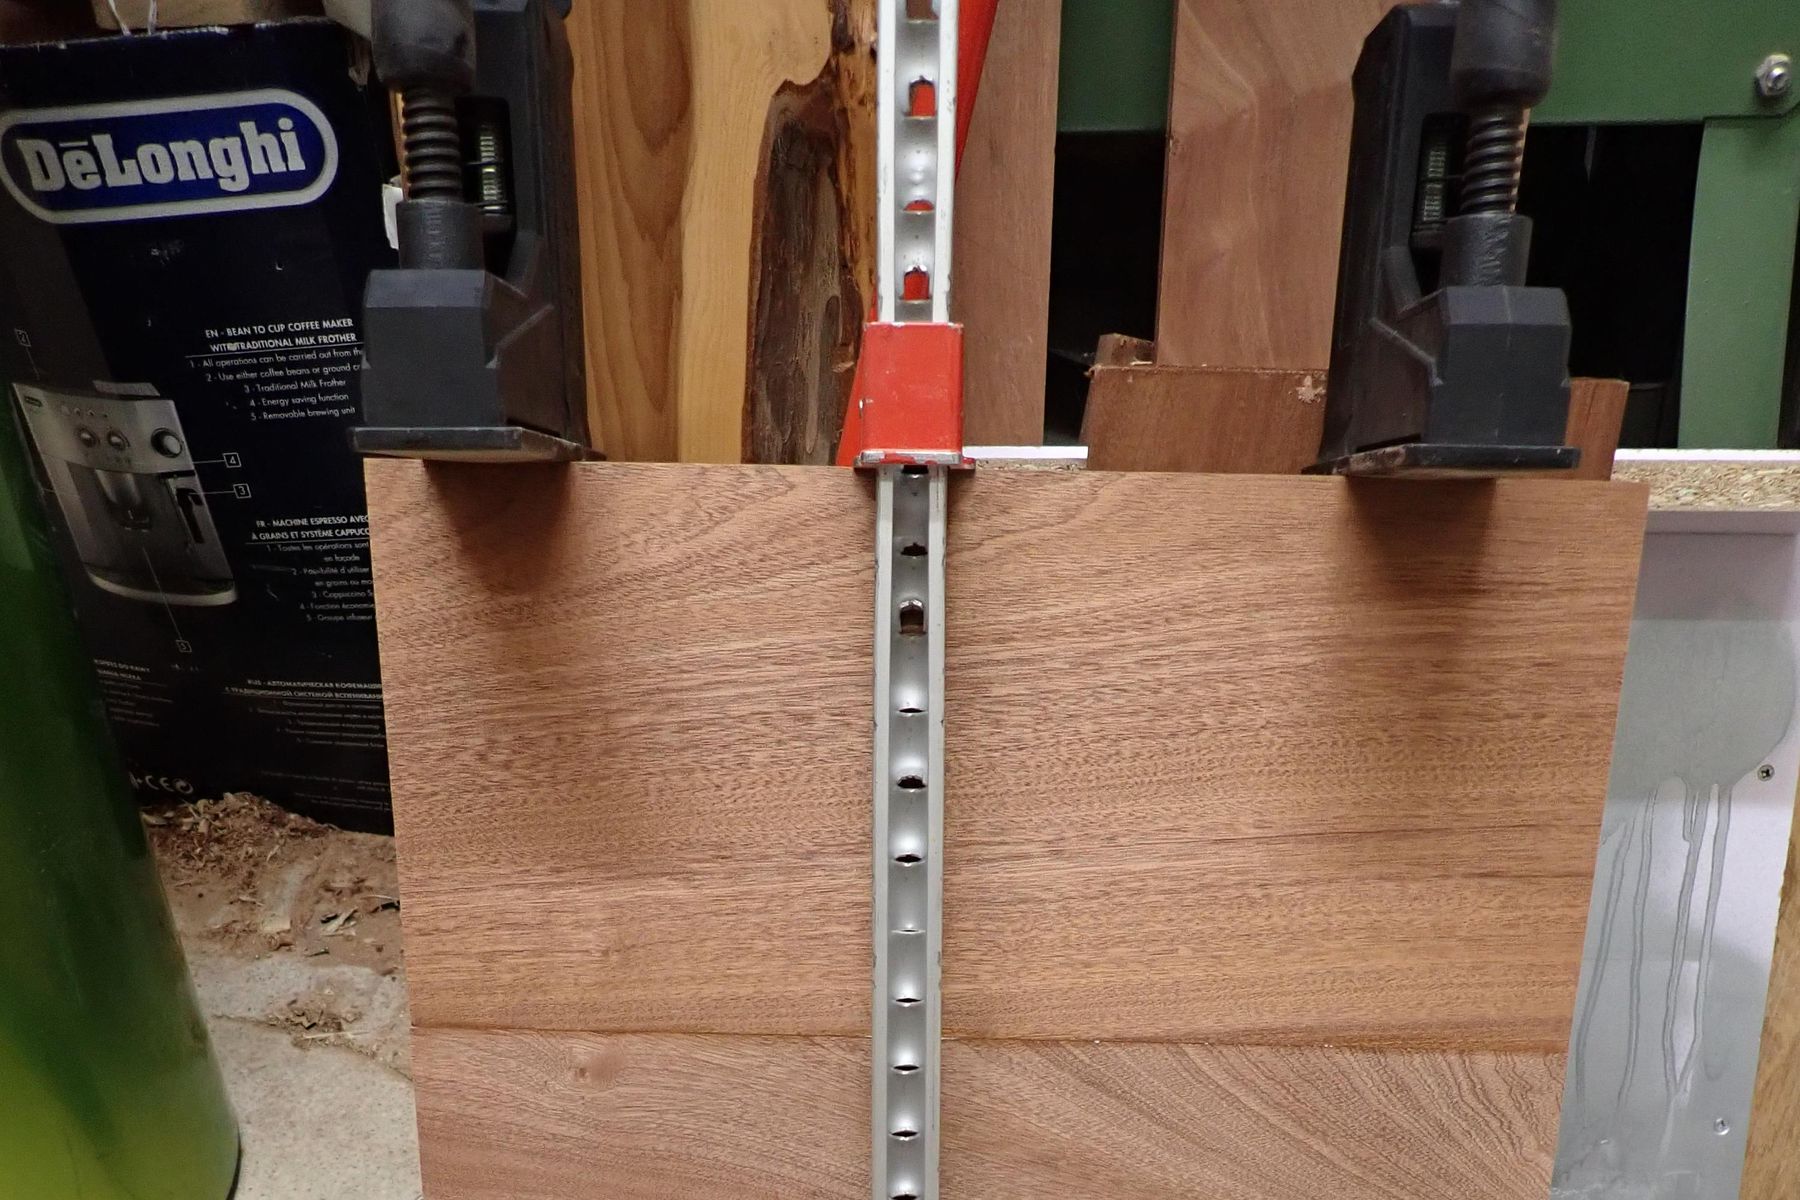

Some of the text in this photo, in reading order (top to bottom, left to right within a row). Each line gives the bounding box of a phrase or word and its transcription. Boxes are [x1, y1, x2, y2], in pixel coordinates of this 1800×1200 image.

[205, 329, 219, 339] EN
[227, 326, 251, 337] BEAN
[253, 324, 266, 334] TO
[268, 323, 286, 333] CUP
[288, 321, 320, 331] COFFEE
[322, 318, 354, 329] MAKER
[235, 338, 293, 351] TRADITIONAL
[295, 336, 316, 346] MILK
[317, 333, 357, 344] FROTHER
[202, 358, 214, 368] All
[215, 354, 258, 369] operations
[259, 355, 275, 364] can
[276, 353, 287, 363] be
[288, 349, 317, 361] carried
[318, 349, 332, 359] out
[333, 346, 352, 358] from
[218, 372, 234, 381] Use
[236, 369, 258, 380] either
[260, 366, 284, 378] coffee
[286, 364, 311, 376] beans
[322, 363, 351, 376] ground
[256, 381, 299, 392] Traditional
[300, 379, 316, 389] Milk
[319, 378, 346, 388] Frother
[262, 397, 290, 408] Energy
[291, 394, 317, 405] saving
[318, 392, 349, 402] function
[263, 408, 306, 420] Removable
[307, 405, 340, 418] brewing
[341, 404, 356, 414] unit
[272, 517, 309, 527] MACHINE
[310, 515, 348, 526] ESPRESSO
[259, 530, 289, 541] GRAINS
[290, 530, 300, 539] ET
